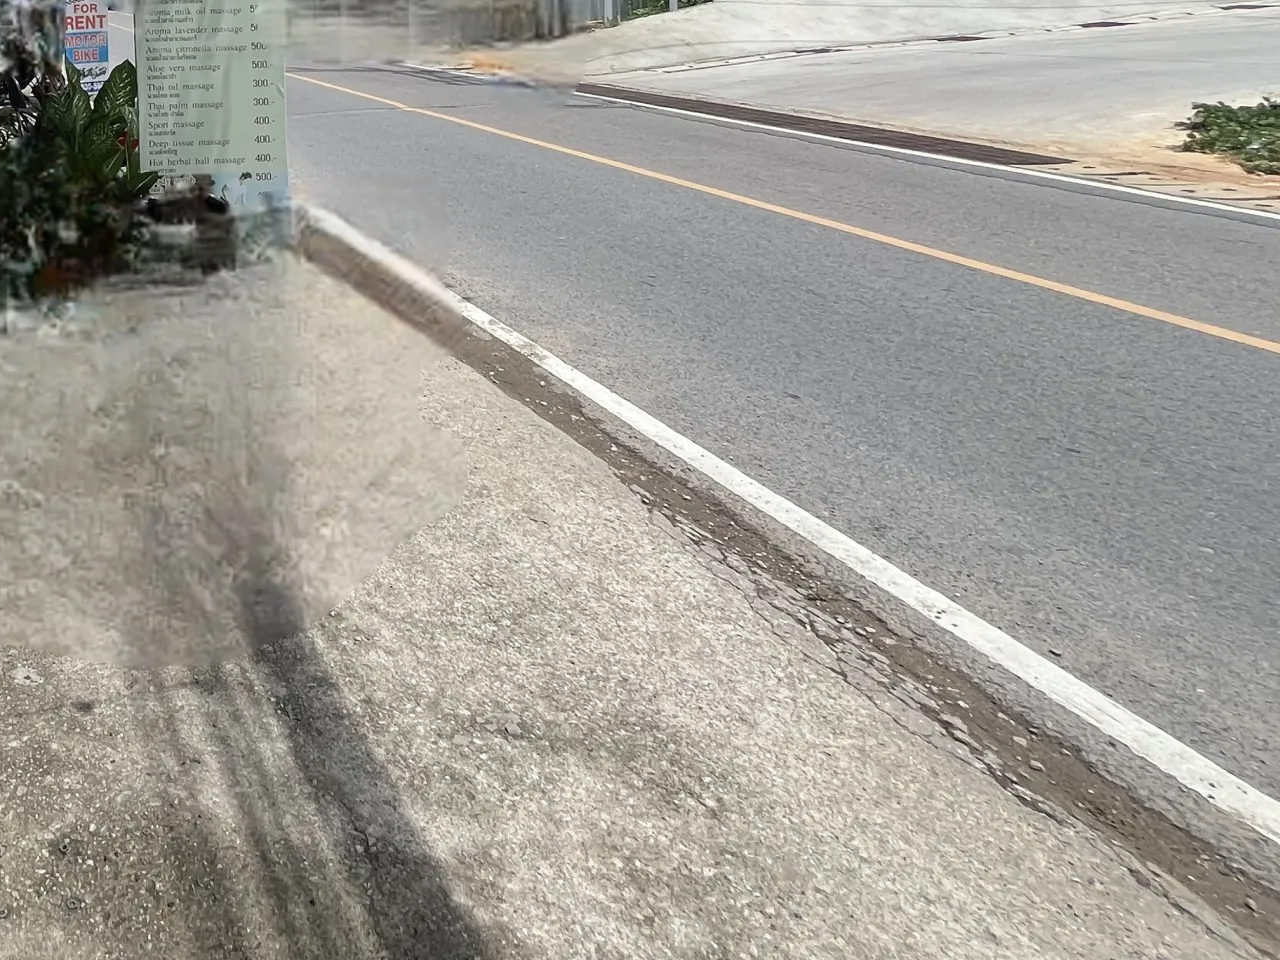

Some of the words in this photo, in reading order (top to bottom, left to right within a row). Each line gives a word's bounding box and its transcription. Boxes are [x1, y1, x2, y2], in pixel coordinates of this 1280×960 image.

[73, 3, 98, 14] FOR
[174, 6, 192, 15] milk
[196, 6, 206, 15] oil
[210, 7, 242, 16] massage
[65, 14, 107, 31] RENT
[145, 28, 171, 36] Aroma
[175, 26, 208, 35] lavender
[211, 26, 243, 35] massage
[65, 34, 106, 48] MOTOR
[73, 49, 99, 62] BIKE
[145, 46, 172, 55] Aroma
[175, 44, 211, 53] citronella
[215, 44, 247, 53] massage
[146, 64, 165, 73] Aloe
[189, 64, 221, 73] massage
[251, 60, 273, 69] 500.-
[147, 83, 164, 92] Thai
[167, 83, 179, 91] oil
[182, 83, 215, 92] massage
[252, 79, 274, 88] 300.-
[147, 102, 165, 111] Thai
[169, 102, 188, 111] palm
[192, 101, 224, 110] massage
[253, 97, 275, 107] 300.-
[148, 121, 169, 131] Sport
[172, 120, 205, 130] massage
[253, 116, 276, 125] 400.-
[148, 140, 169, 149] Deep
[172, 139, 194, 147] tissue
[198, 139, 231, 148] massage
[254, 135, 276, 144] 400.-
[149, 159, 163, 167] Hot
[167, 158, 191, 166] herbal
[195, 157, 210, 166] ball
[213, 157, 246, 166] massage
[255, 153, 278, 163] 400.-
[255, 172, 278, 181] 500.-
